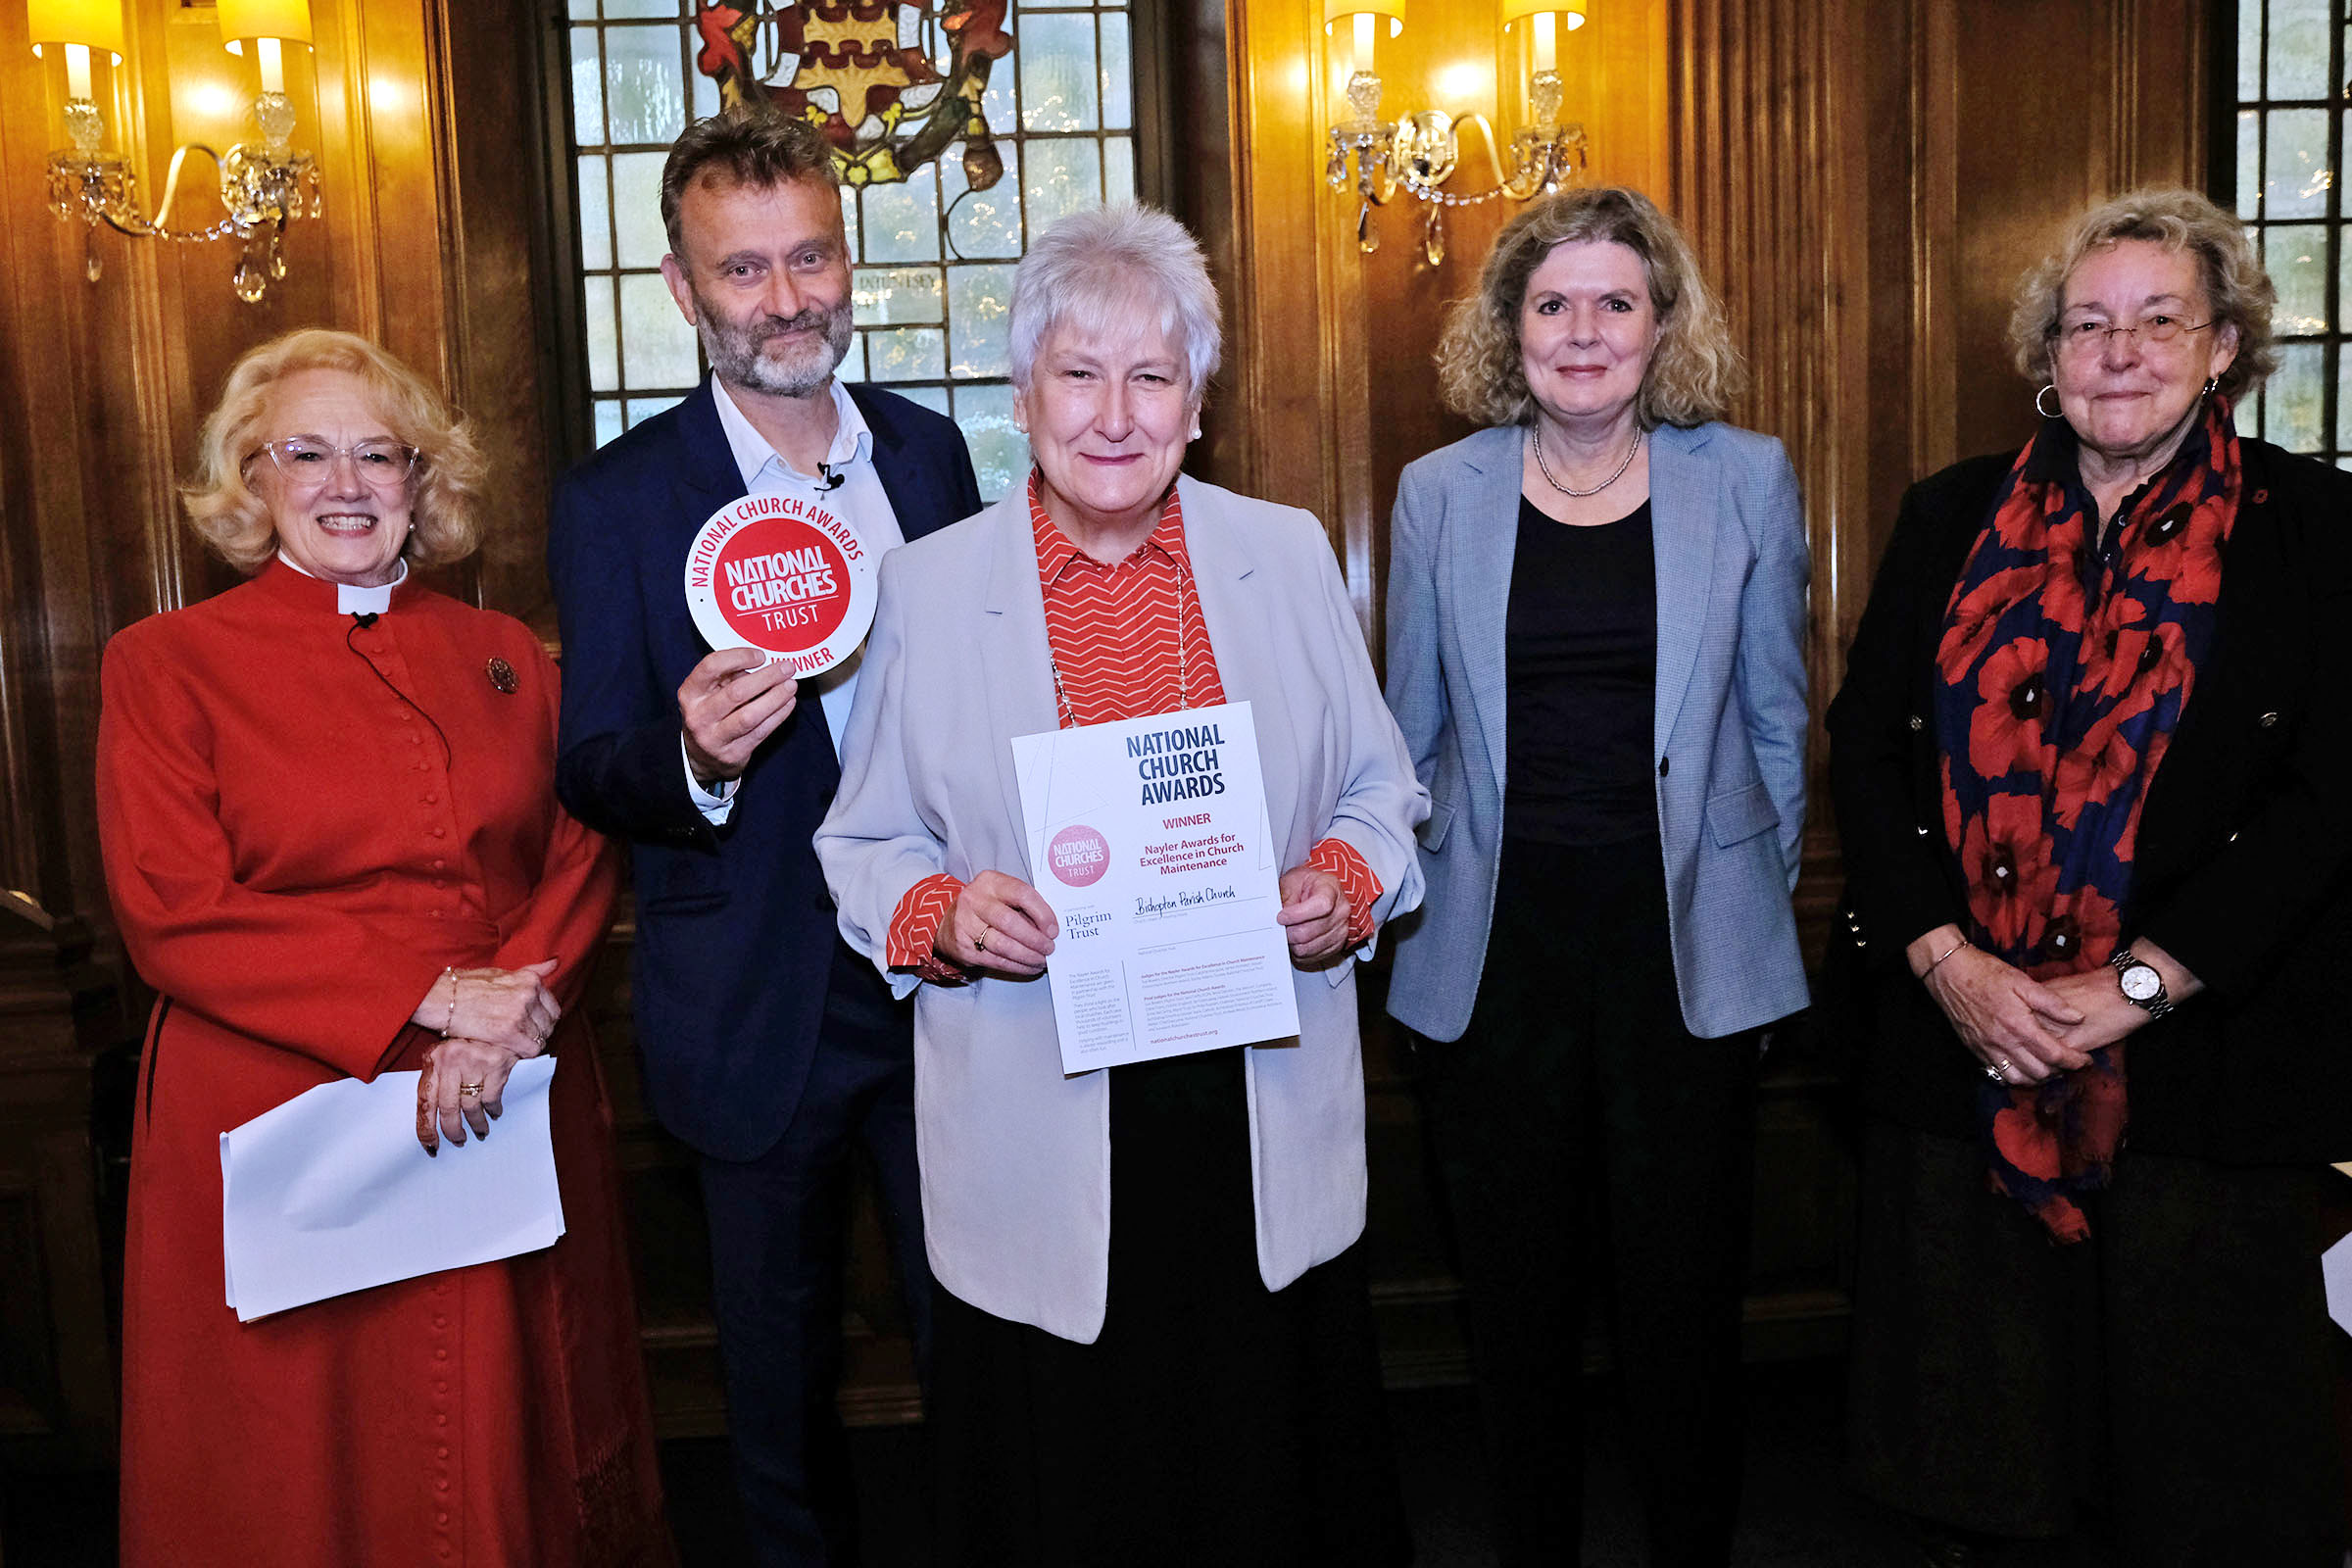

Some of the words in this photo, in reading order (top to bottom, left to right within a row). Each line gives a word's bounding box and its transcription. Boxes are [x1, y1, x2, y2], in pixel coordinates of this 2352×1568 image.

[692, 515, 738, 587] NATIONAL
[737, 497, 804, 520] CHURCH
[807, 506, 863, 561] AWARDS
[724, 546, 830, 587] NATIONAL
[731, 568, 838, 612] CHURCHES
[761, 604, 818, 631] TRUST
[771, 647, 834, 672] NNER
[1126, 724, 1225, 758] NATIONAL
[1139, 749, 1219, 780] CHURCH
[1142, 773, 1225, 806] AWARDS
[1162, 812, 1211, 830] WINNER
[1054, 838, 1102, 857] NATIONAL
[1140, 852, 1194, 867] Excellence
[1196, 850, 1205, 858] in
[1207, 843, 1245, 857] Church
[1145, 843, 1178, 856] Nayler
[1181, 835, 1219, 850] Awards
[1220, 833, 1236, 843] for
[1055, 850, 1103, 867] CHURCHES
[1160, 858, 1227, 875] Maintenance
[1068, 865, 1095, 878] TRUST
[1135, 895, 1177, 917] Bishopton
[1179, 891, 1204, 906] Parish
[1205, 885, 1236, 902] Church
[1065, 910, 1112, 928] Pilgrim
[1066, 927, 1100, 940] Trust
[1151, 1029, 1218, 1045] nationalchurchestrust.org
